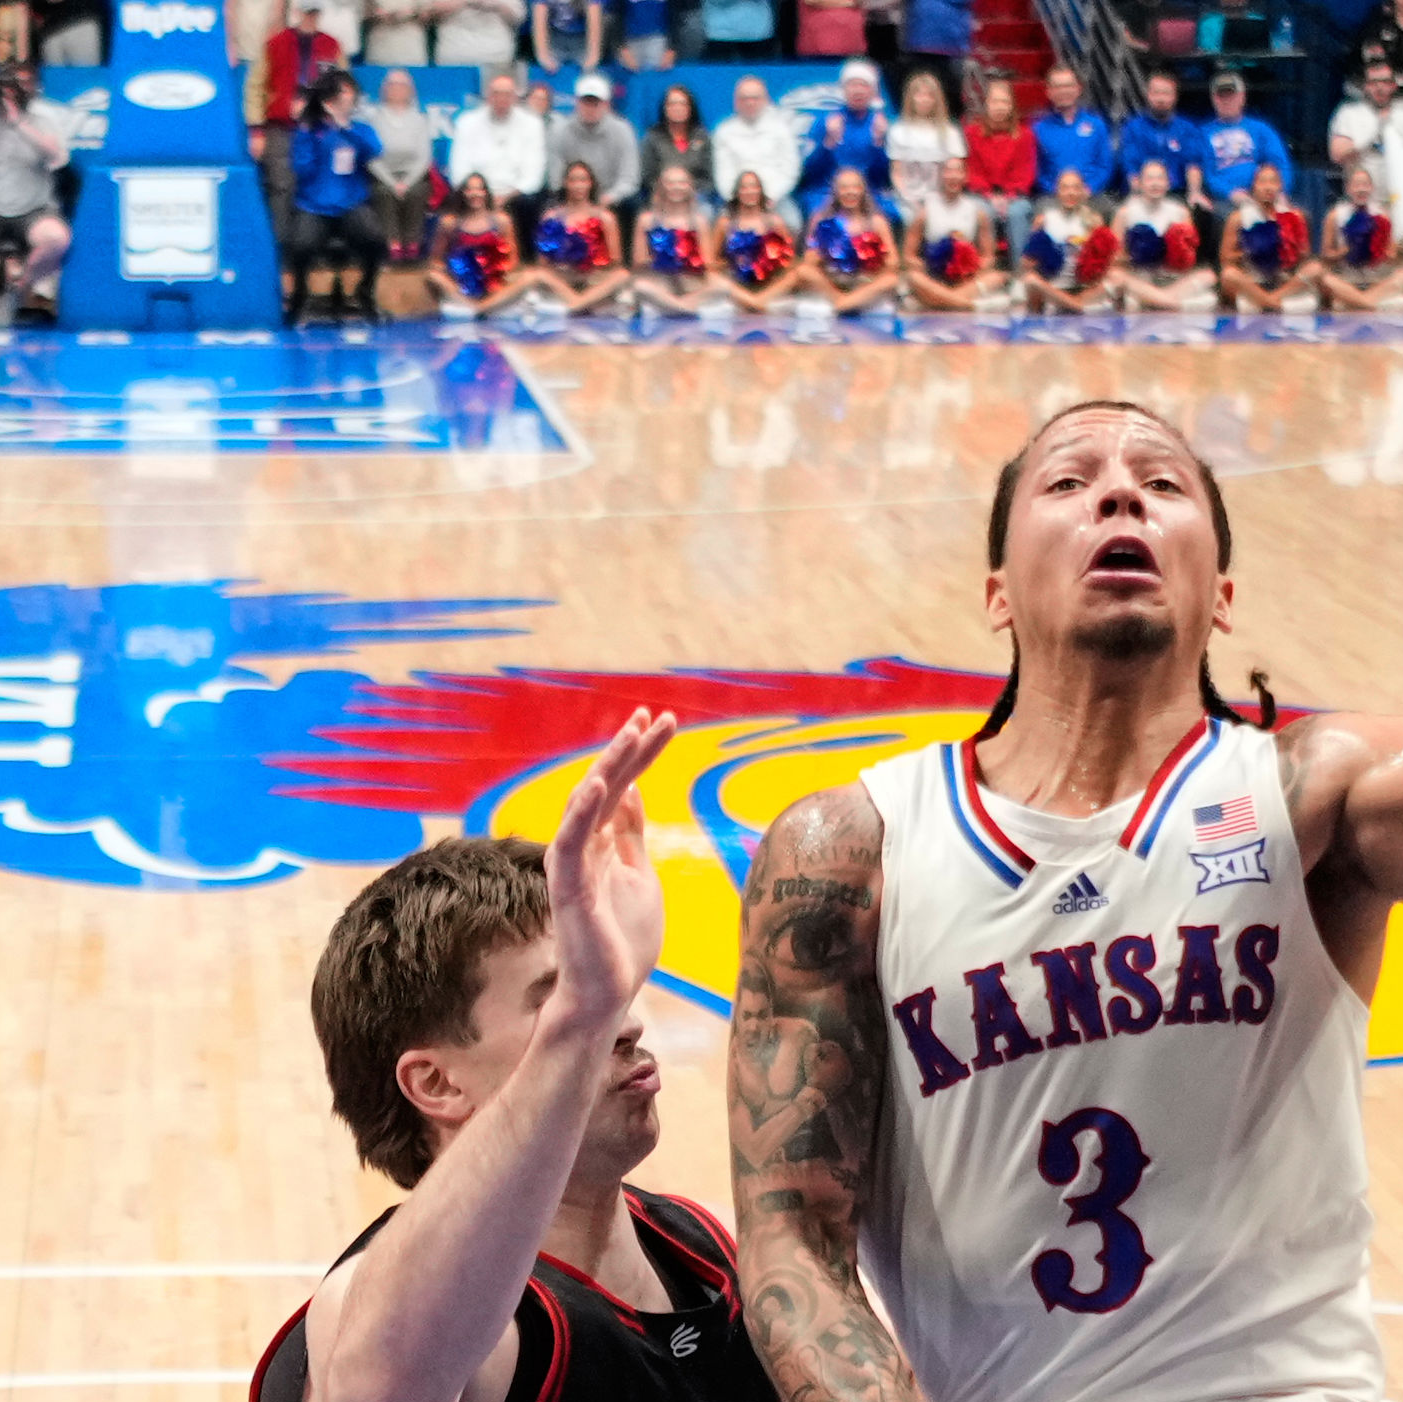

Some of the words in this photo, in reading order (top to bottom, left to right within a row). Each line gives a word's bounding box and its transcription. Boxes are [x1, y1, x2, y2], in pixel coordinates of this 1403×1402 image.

[1052, 896, 1110, 916] adidas
[892, 923, 1280, 1098] KANSAS
[1031, 1107, 1154, 1314] 3
